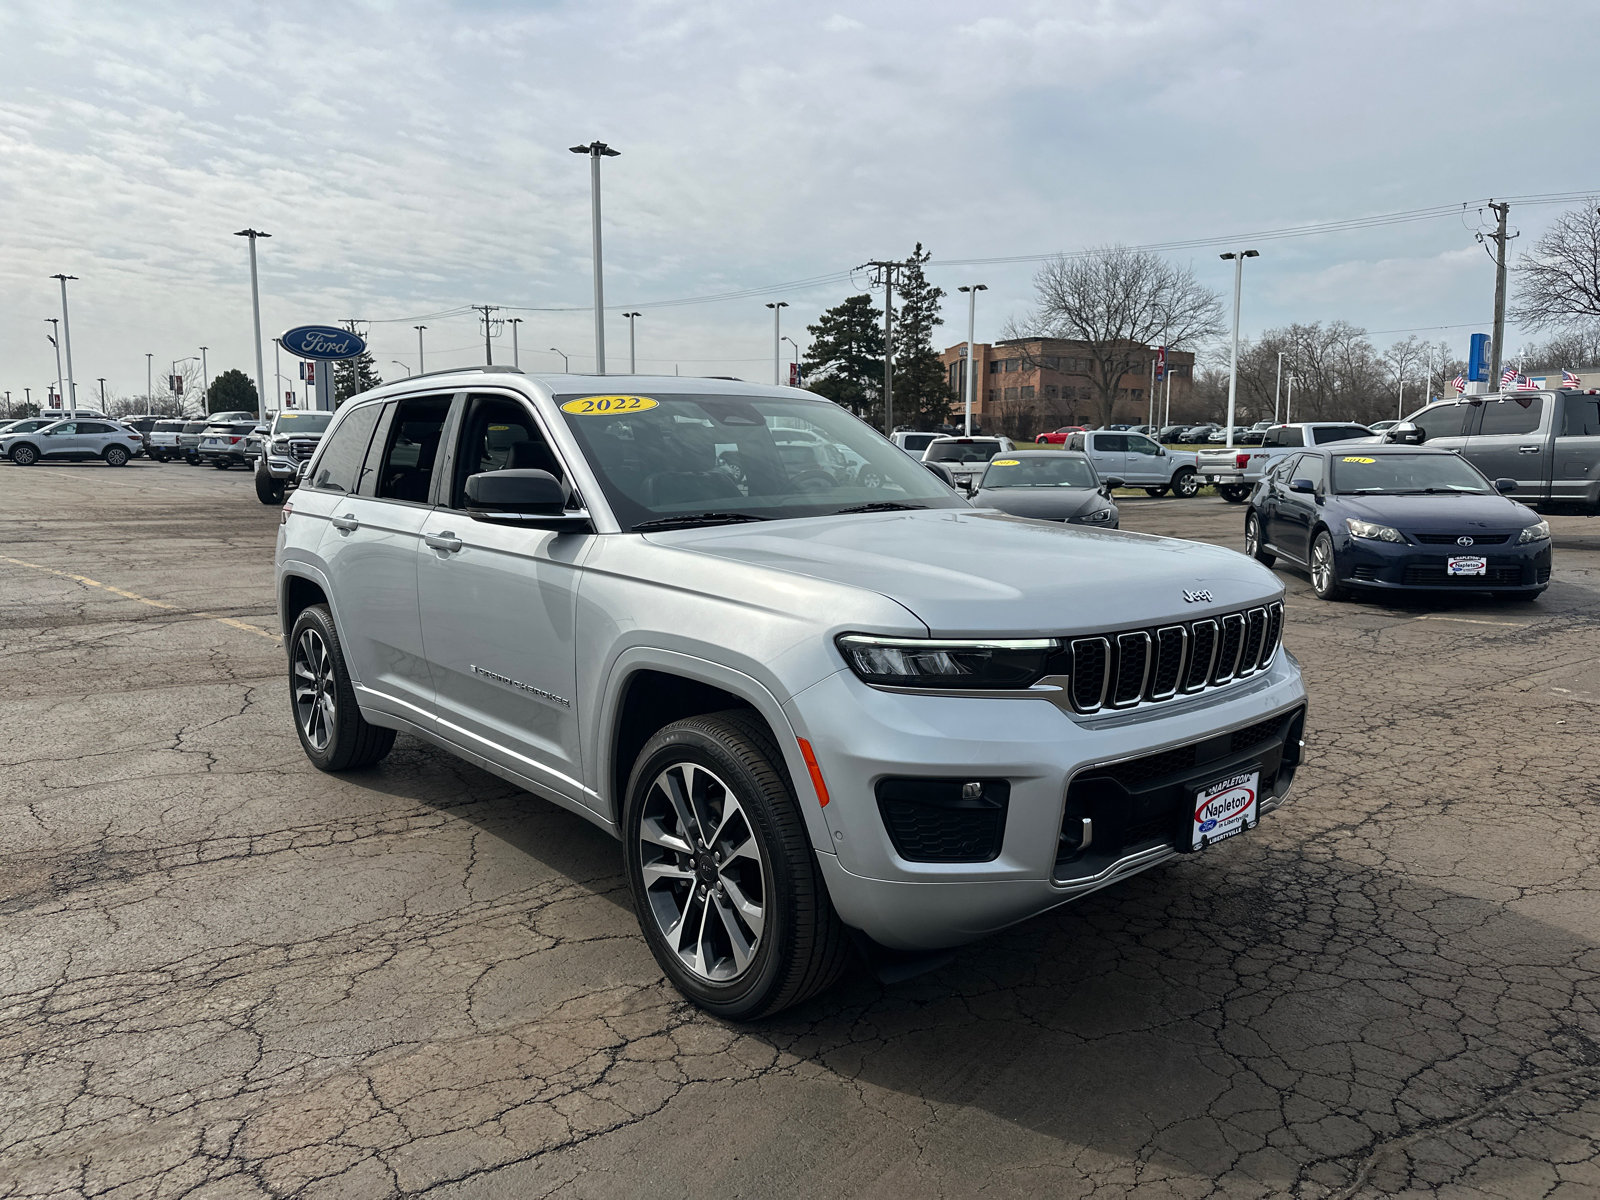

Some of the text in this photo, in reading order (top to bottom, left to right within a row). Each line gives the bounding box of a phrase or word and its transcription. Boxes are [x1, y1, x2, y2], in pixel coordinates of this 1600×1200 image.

[301, 331, 350, 354] Ford
[581, 397, 641, 413] 2022
[1182, 588, 1213, 603] Jeep
[478, 667, 571, 708] GRAND CHEROKEE
[1205, 796, 1246, 819] Napleton
[1223, 813, 1250, 827] Libertyville
[1209, 826, 1242, 845] LIBERTYVILLE
